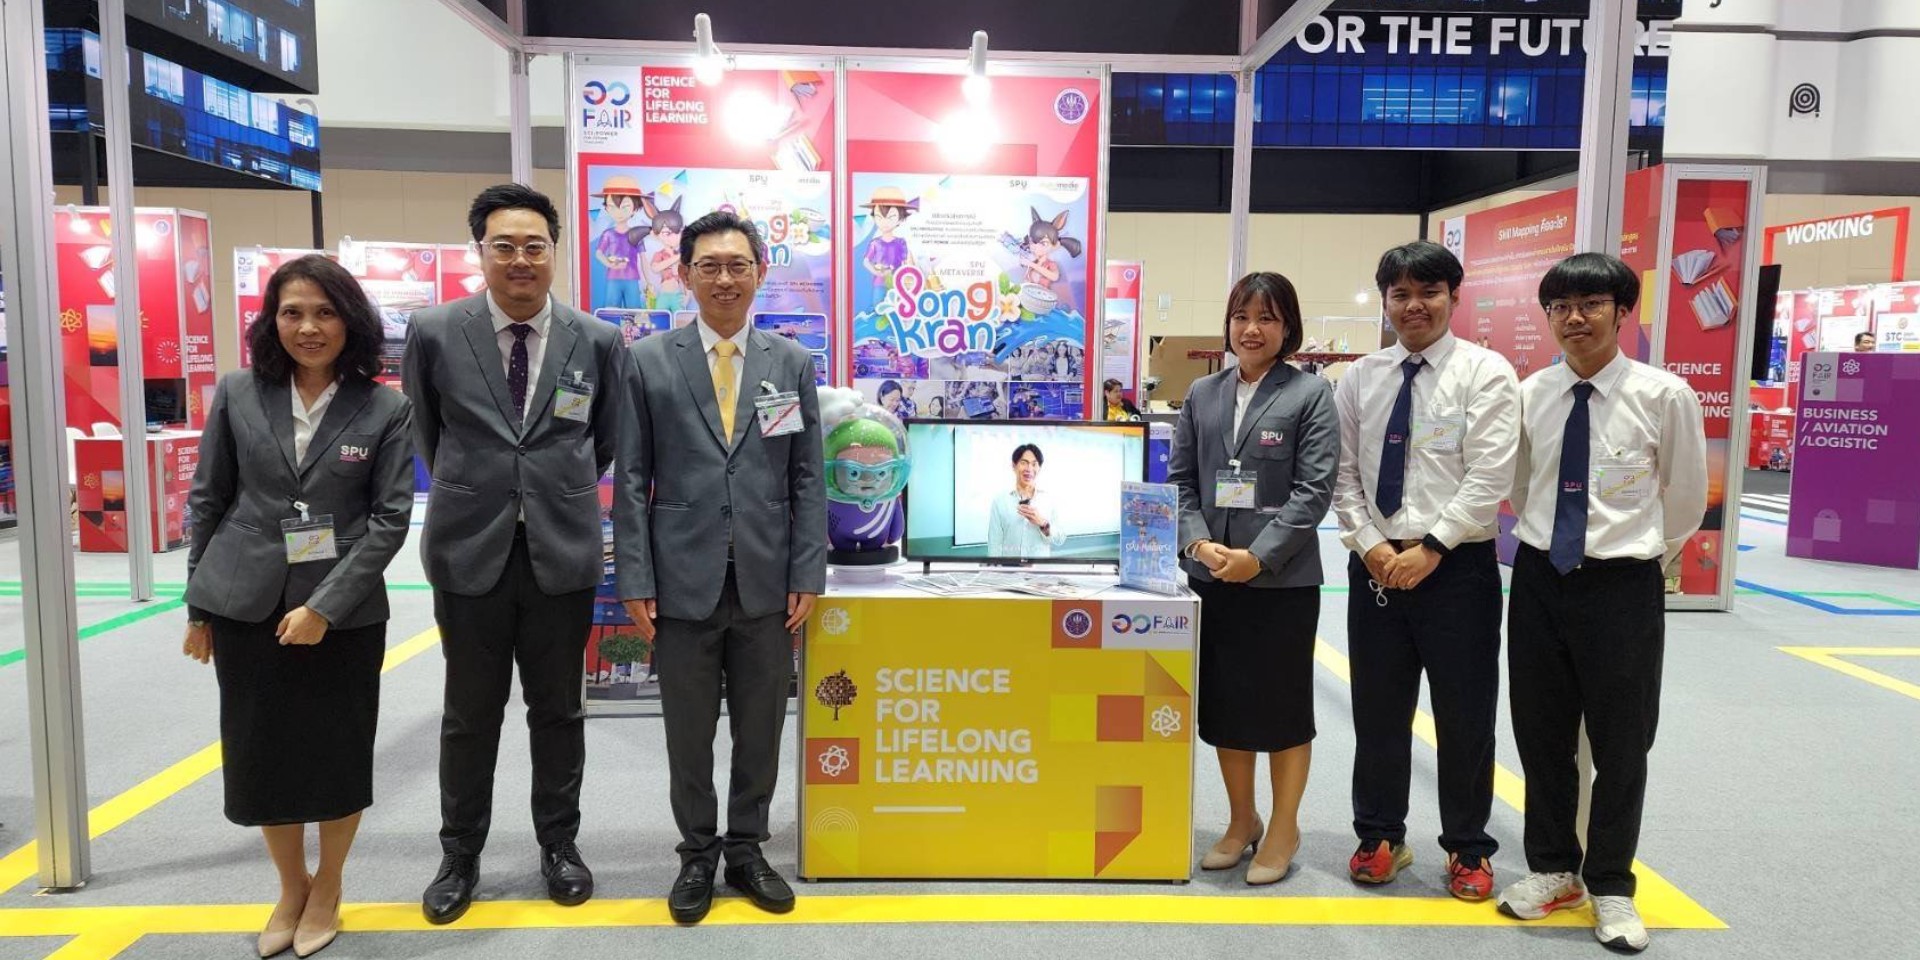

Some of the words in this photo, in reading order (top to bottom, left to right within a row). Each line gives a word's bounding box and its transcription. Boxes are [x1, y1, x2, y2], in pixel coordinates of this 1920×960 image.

[1381, 16, 1472, 55] THE
[644, 75, 696, 88] SCIENCE
[645, 88, 670, 99] FOR
[645, 100, 705, 112] LIFELONG
[583, 108, 632, 128] FAIR
[645, 111, 708, 123] LEARNING
[1498, 226, 1514, 241] Skill
[1512, 223, 1541, 239] Mapping
[1786, 214, 1875, 245] WORKING
[896, 266, 993, 321] Song
[1804, 407, 1878, 421] BUSINESS
[1261, 431, 1284, 441] SPU
[1813, 421, 1888, 436] AVIATION
[1800, 435, 1878, 449] /LOGISTIC
[340, 445, 369, 457] SPU
[1152, 615, 1188, 630] FAIR
[875, 668, 1011, 693] SCIENCE
[875, 698, 941, 723] FOR
[875, 728, 1033, 756] LIFELONG
[875, 759, 1040, 785] LEARNING
